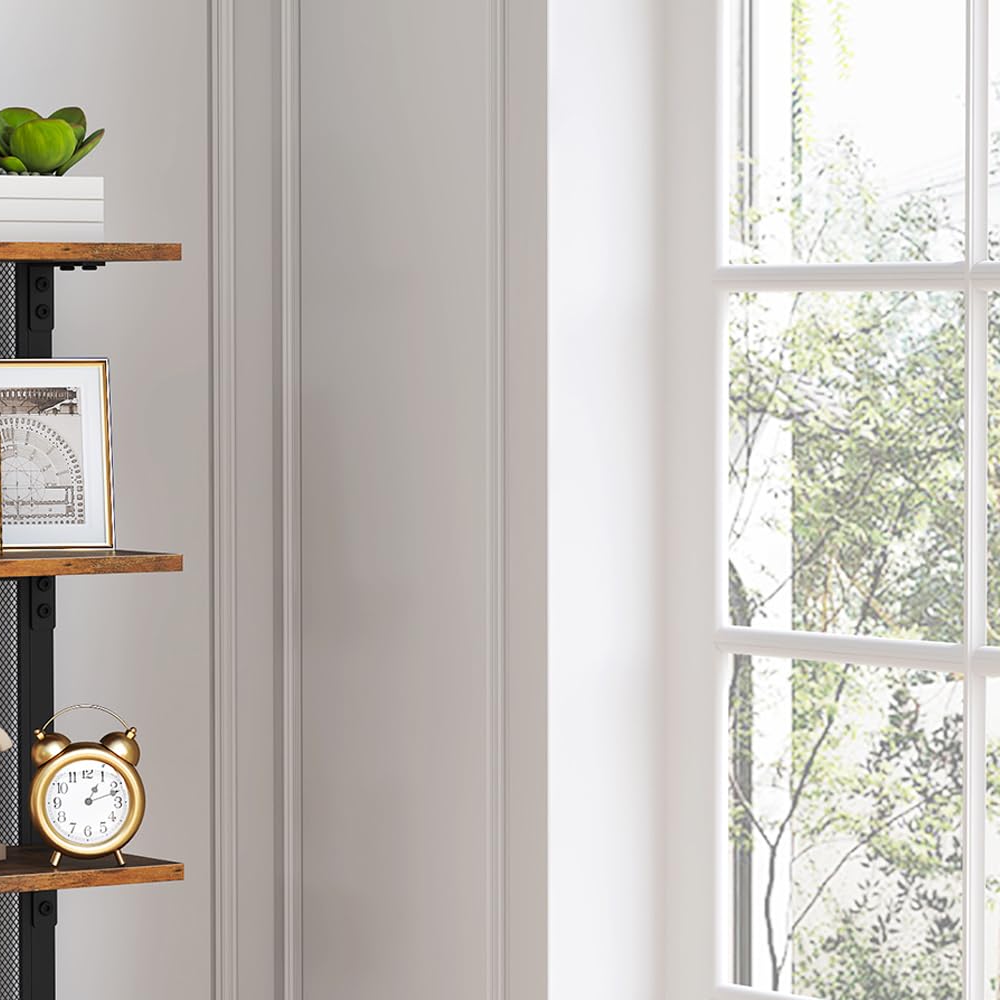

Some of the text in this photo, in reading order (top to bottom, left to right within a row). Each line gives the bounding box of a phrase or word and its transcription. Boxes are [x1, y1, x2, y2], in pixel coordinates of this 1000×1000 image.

[68, 771, 77, 783] 11
[82, 769, 94, 779] 12
[100, 771, 105, 782] 1
[57, 782, 68, 794] 10
[53, 797, 62, 808] 9
[113, 797, 123, 808] 3
[57, 811, 66, 822] 8
[108, 811, 117, 822] 4
[69, 822, 77, 834] 7
[83, 825, 92, 837] 6
[99, 822, 108, 833] 5
